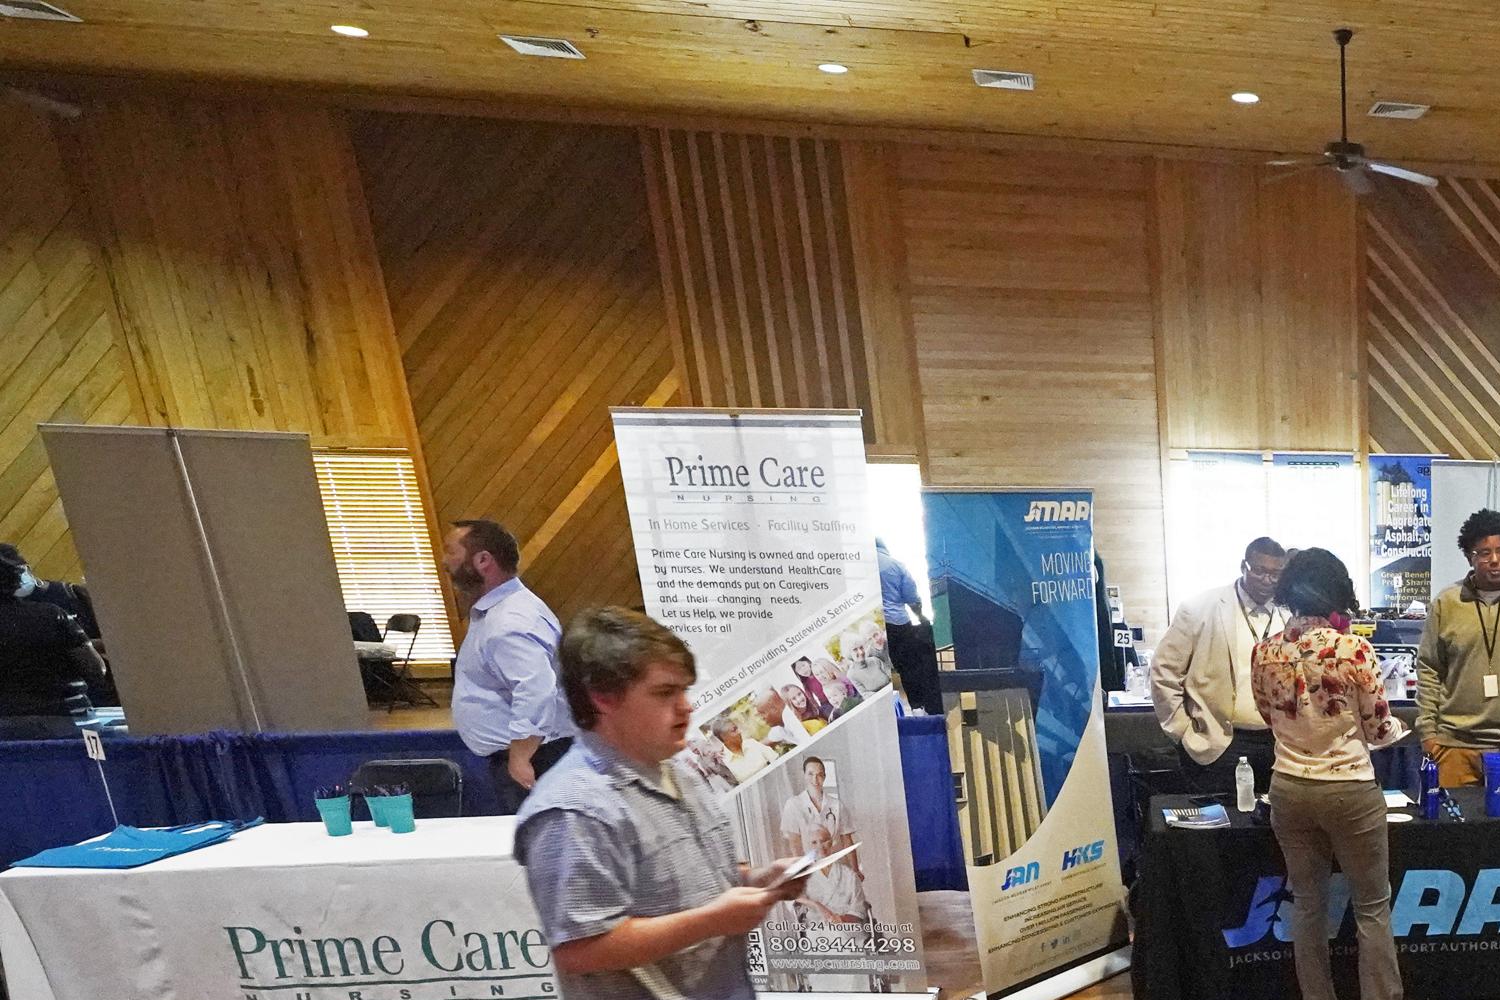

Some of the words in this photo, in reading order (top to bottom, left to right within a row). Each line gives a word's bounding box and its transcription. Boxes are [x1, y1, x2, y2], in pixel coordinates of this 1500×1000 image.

[665, 455, 750, 487] Prime
[759, 457, 825, 488] Care
[677, 494, 821, 502] NURSING
[1391, 484, 1427, 501] Lifelong
[1388, 500, 1418, 513] Career
[1420, 500, 1429, 513] in
[648, 519, 660, 530] In
[664, 519, 697, 530] Home
[701, 518, 750, 531] Services
[768, 519, 808, 533] Facility
[812, 519, 856, 533] Staffing
[1385, 529, 1422, 545] Asphalt,
[651, 549, 681, 559] Prime
[683, 549, 707, 559] Care
[709, 549, 746, 561] Nursing
[749, 550, 757, 560] is
[759, 550, 794, 560] owned
[796, 550, 815, 560] and
[817, 550, 861, 562] operated
[1381, 544, 1432, 558] Constructio
[654, 564, 667, 576] by
[671, 566, 705, 575] nurses.
[709, 564, 726, 574] We
[729, 565, 783, 575] understand
[788, 565, 842, 576] HealthCare
[1041, 552, 1092, 576] MOVING
[657, 579, 676, 589] and
[678, 579, 694, 589] the
[697, 579, 742, 589] demands
[744, 581, 760, 592] put
[778, 580, 829, 592] Caregivers
[1031, 577, 1093, 605] FORWARD
[659, 593, 678, 603] and
[686, 594, 708, 603] their
[717, 594, 762, 606] changing
[770, 594, 802, 605] needs.
[662, 608, 677, 618] Let
[679, 610, 691, 618] us
[720, 610, 735, 619] we
[737, 608, 773, 621] provide
[704, 623, 718, 633] for
[720, 623, 732, 633] all
[1117, 633, 1130, 644] 25
[701, 690, 714, 704] 25
[713, 678, 738, 698] years
[739, 668, 748, 680] of
[747, 644, 788, 675] providing
[785, 614, 828, 647] Statewide
[827, 592, 865, 619] Services
[87, 735, 99, 755] 17
[1061, 839, 1105, 871] HKS
[766, 920, 789, 932] Call
[794, 922, 807, 932] us
[810, 920, 826, 932] 24
[828, 920, 861, 932] hours
[864, 923, 874, 933] a
[875, 921, 897, 935] day
[899, 922, 913, 933] at
[223, 926, 404, 980] Prime
[421, 919, 551, 973] Care
[769, 937, 916, 953] 800.844.4298
[1394, 942, 1436, 954] PORT
[770, 957, 921, 971] www.pcnursing.com
